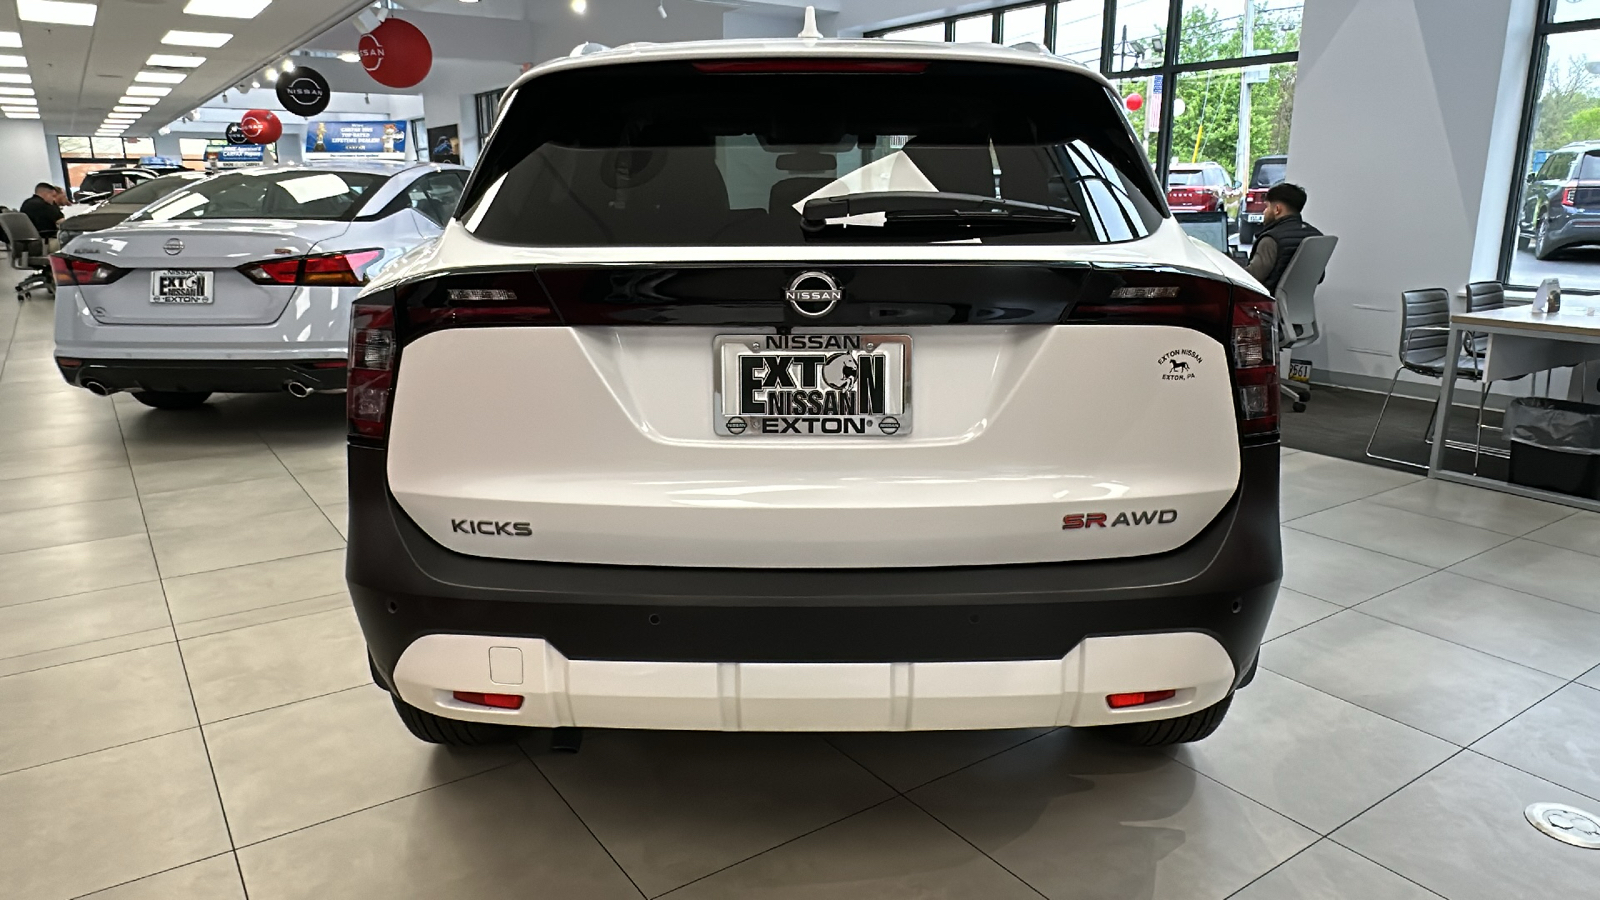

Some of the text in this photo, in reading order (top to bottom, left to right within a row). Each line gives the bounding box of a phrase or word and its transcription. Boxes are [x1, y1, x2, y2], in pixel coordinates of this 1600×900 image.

[286, 88, 323, 96] NISSAN
[786, 291, 841, 300] NISSAN
[766, 335, 860, 350] NISSAN
[1157, 349, 1203, 365] EXTON NISSAN
[767, 390, 857, 415] NISSAN
[762, 418, 866, 434] EXTON
[451, 518, 533, 536] KICKS
[1062, 508, 1178, 530] SR AWD
